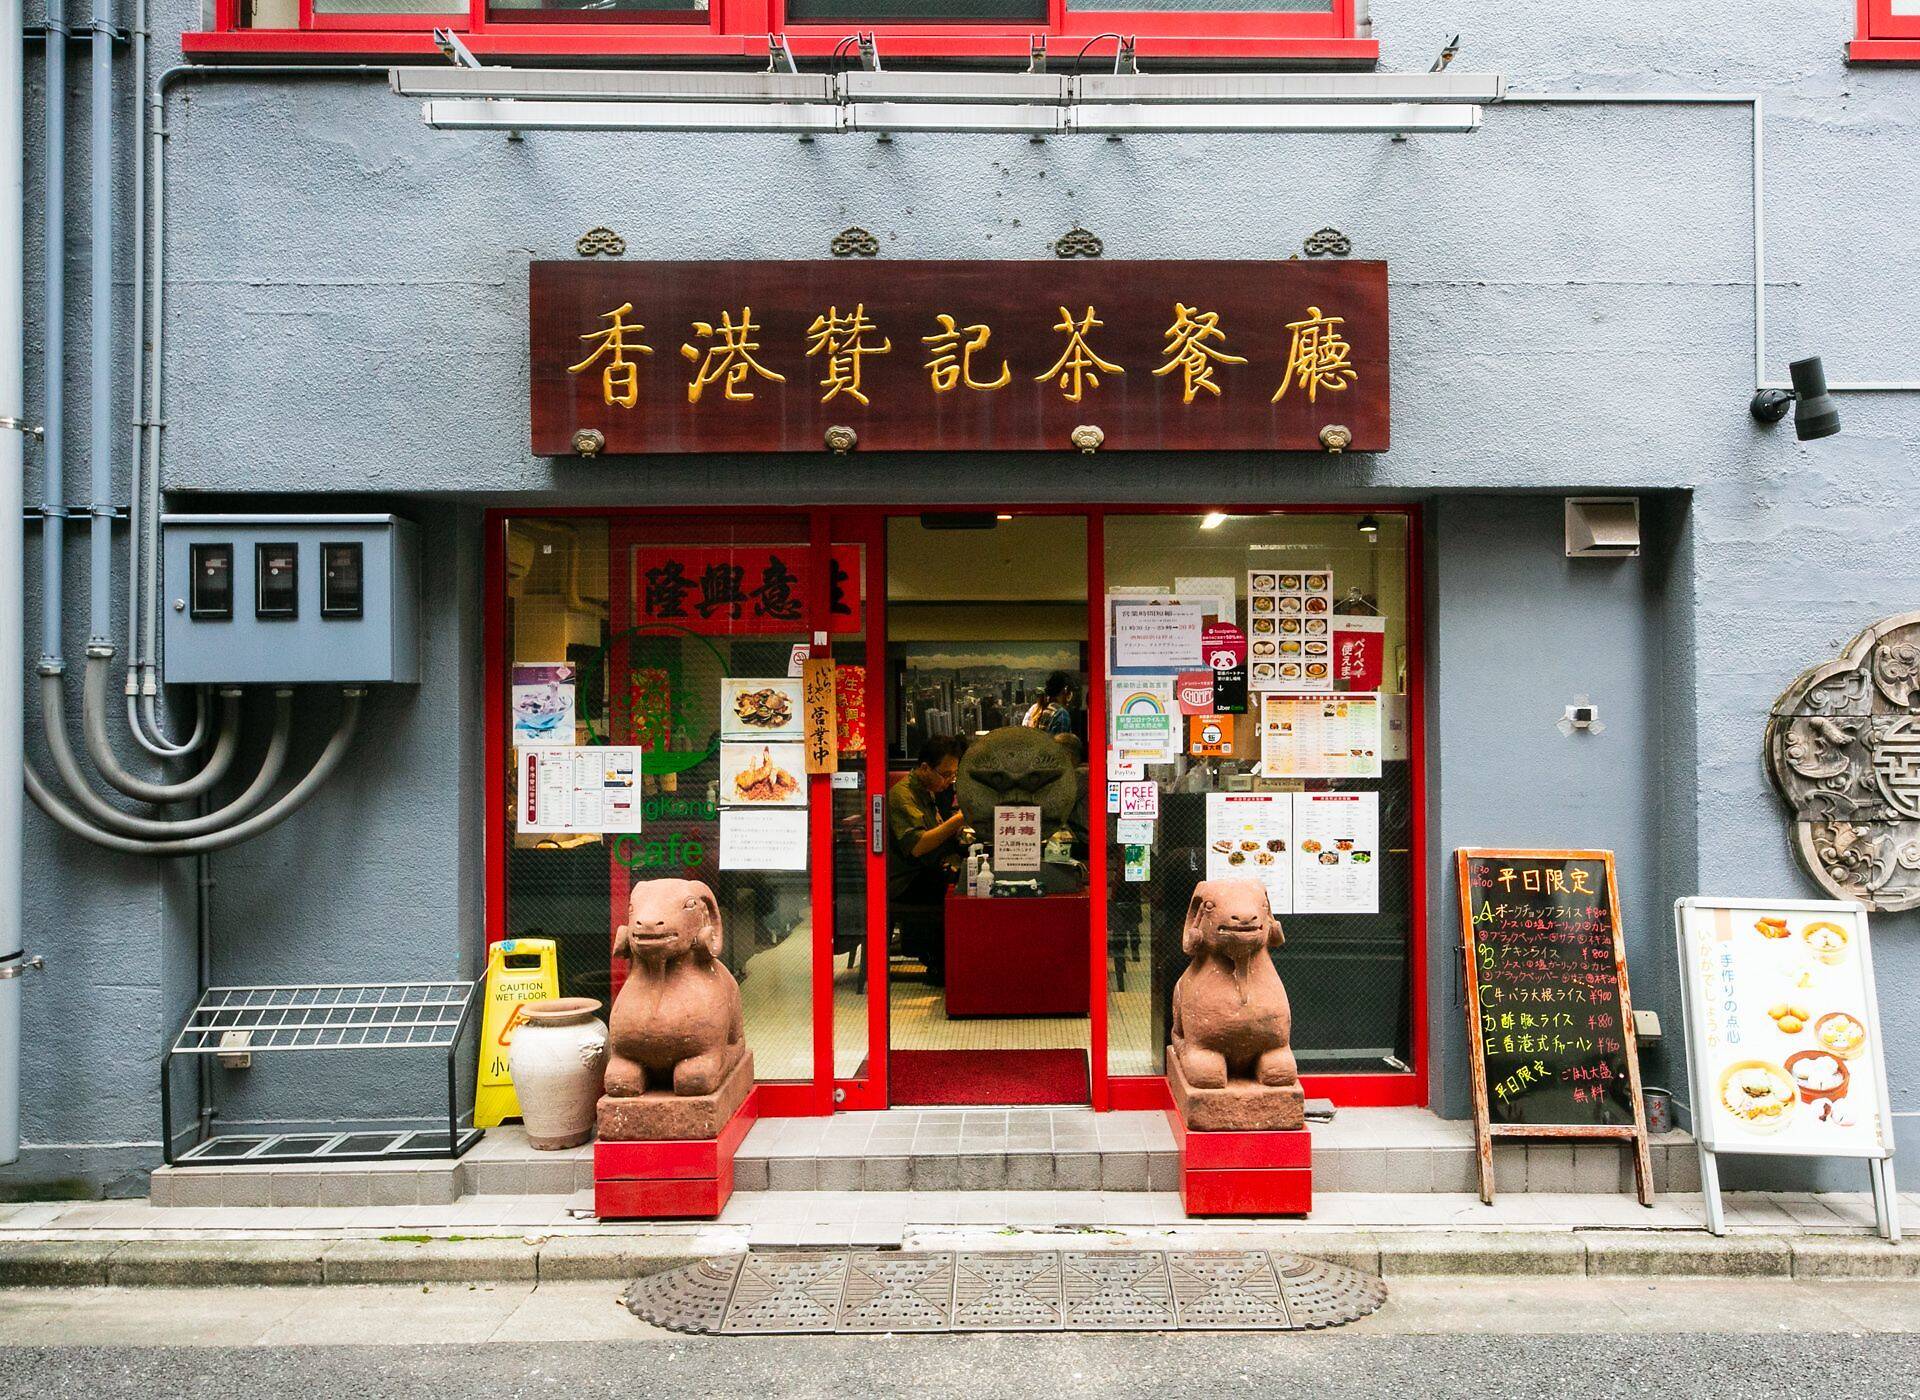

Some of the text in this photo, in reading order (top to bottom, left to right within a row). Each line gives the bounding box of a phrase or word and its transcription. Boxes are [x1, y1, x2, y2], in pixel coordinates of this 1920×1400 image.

[1341, 643, 1352, 679] 使えま
[810, 706, 830, 766] 営業中
[1125, 787, 1154, 797] FREE
[1125, 800, 1154, 810] Wi-Fi
[999, 812, 1036, 821] 手指
[999, 826, 1036, 836] 消毒
[1498, 868, 1594, 895] 平日限定
[1501, 944, 1560, 959] チキンライス
[499, 983, 543, 992] CAUTION
[495, 991, 547, 1001] WET FLOOR
[1590, 990, 1612, 1005] ¥900
[1501, 1012, 1574, 1029] 酢豚ライス
[1503, 1035, 1593, 1054] 香港式チャーハン
[491, 1056, 510, 1077] 小
[1495, 1060, 1551, 1105] 平日限定
[1573, 1084, 1606, 1103] 無料
